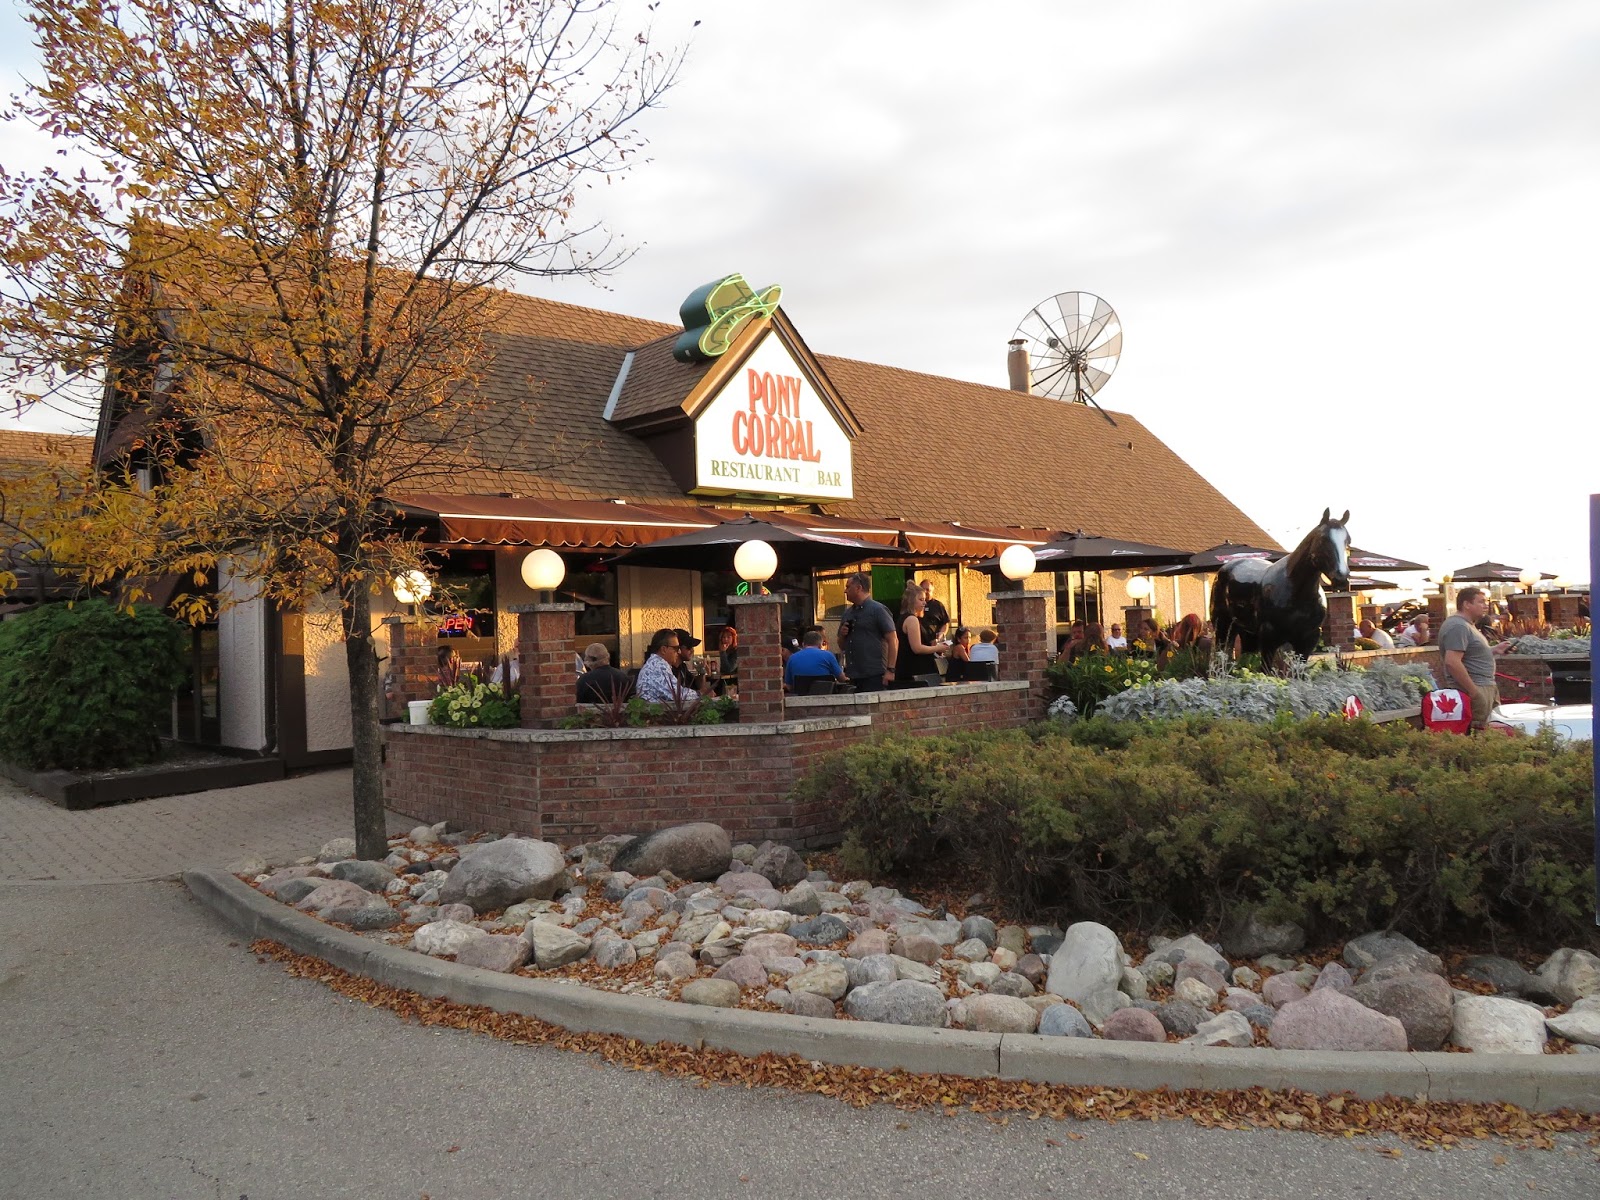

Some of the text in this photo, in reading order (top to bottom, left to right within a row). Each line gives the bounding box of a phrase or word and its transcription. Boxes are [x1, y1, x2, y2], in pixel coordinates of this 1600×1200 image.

[748, 368, 801, 418] PONY
[732, 410, 821, 463] CORRAL
[711, 460, 842, 487] RESTAURANT BAR
